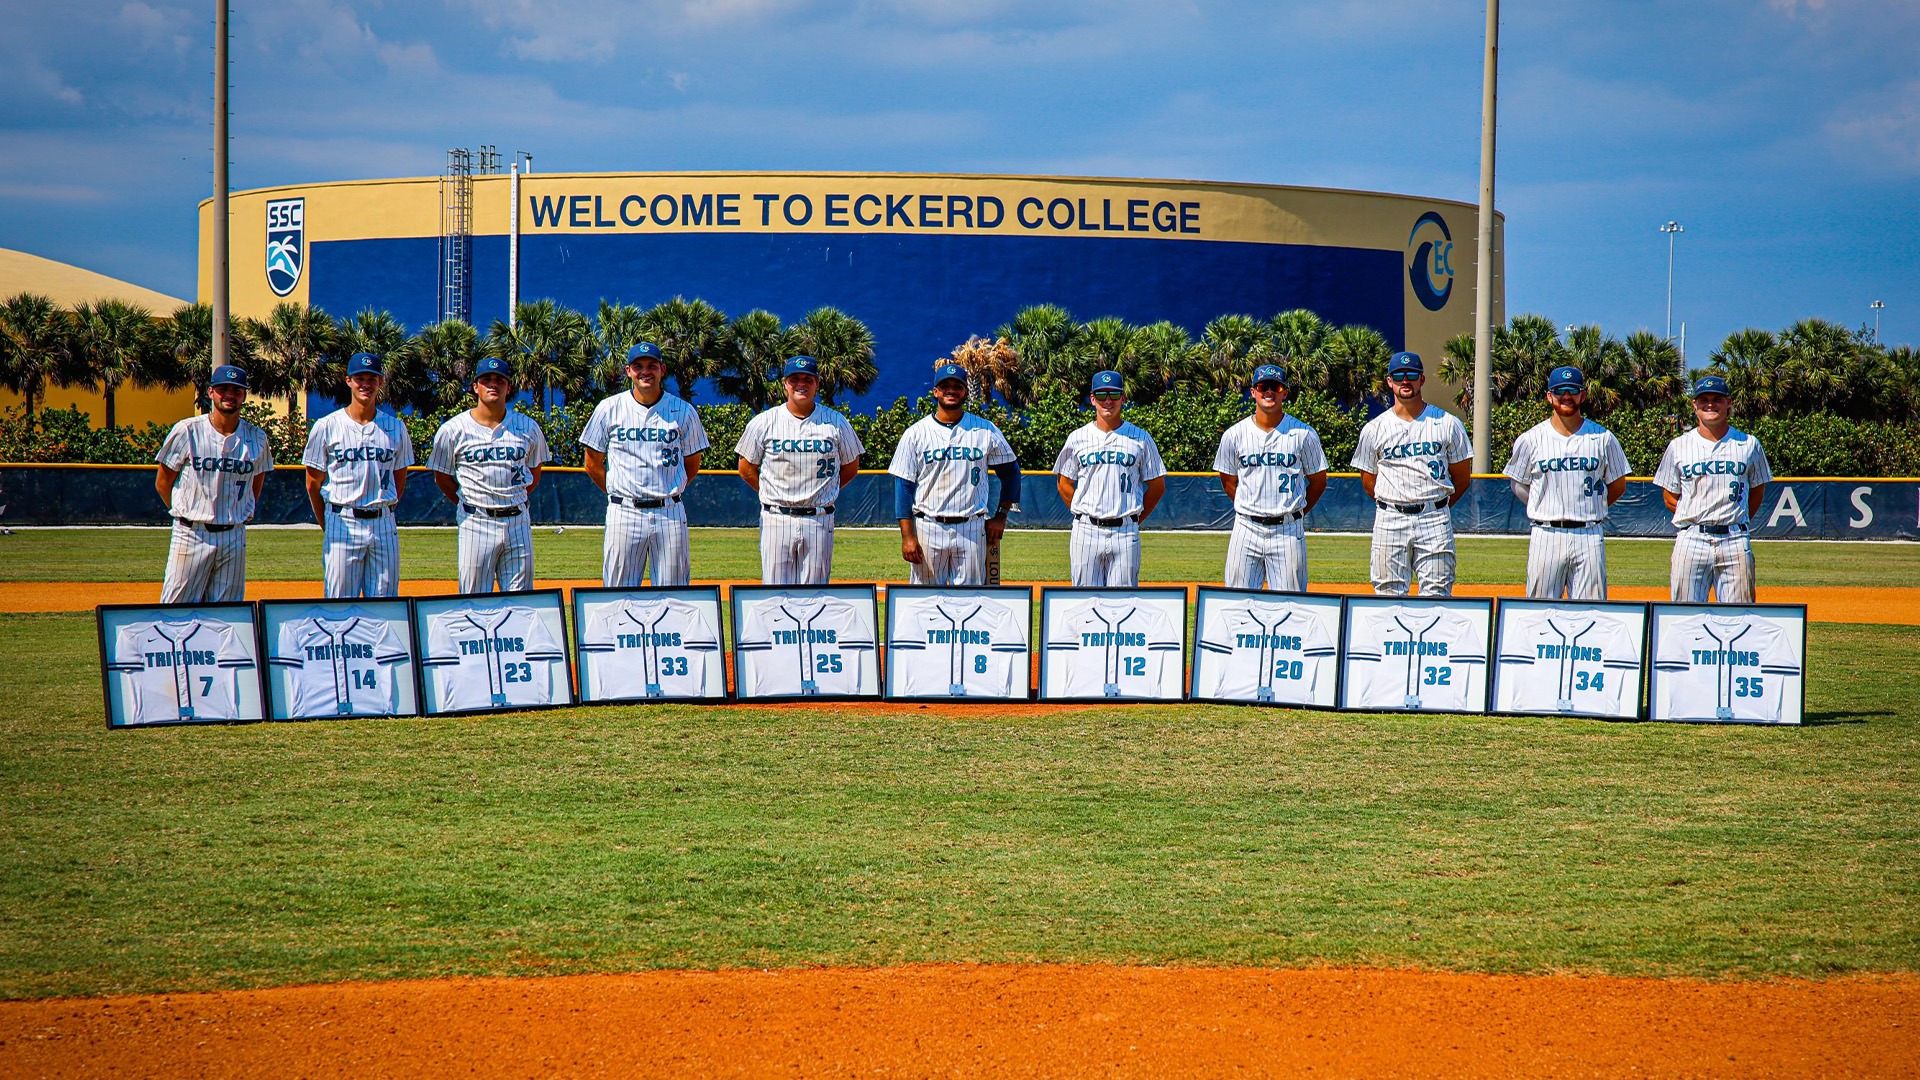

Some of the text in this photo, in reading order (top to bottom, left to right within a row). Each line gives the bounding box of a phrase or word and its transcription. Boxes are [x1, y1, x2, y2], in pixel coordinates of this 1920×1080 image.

[269, 204, 302, 228] SSC
[529, 193, 1201, 234] WELCOME TO ECKERD COLLEGE
[1434, 240, 1455, 276] EC
[617, 427, 679, 444] ECKERD
[334, 446, 394, 463] ECKERD
[464, 446, 526, 463] ECKERD
[773, 439, 834, 454] ECKERD
[923, 446, 984, 464] ECKERD
[1383, 441, 1442, 460] ECKERD
[192, 456, 254, 475] ECKERD
[816, 458, 836, 479] 25
[1079, 450, 1137, 468] ECKERD
[1239, 452, 1298, 468] ECKERD
[1538, 456, 1600, 474] ECKERD
[970, 467, 981, 487] 8
[1682, 460, 1747, 479] ECKERD
[235, 480, 247, 501] 7
[1583, 476, 1605, 497] 34
[459, 637, 525, 655] TRITONS
[617, 632, 682, 648] TRITONS
[773, 629, 836, 645] TRITONS
[927, 629, 990, 645] TRITONS
[1082, 632, 1145, 647] TRITONS
[1236, 634, 1302, 650] TRITONS
[305, 643, 373, 661] TRITONS
[1384, 641, 1448, 656] TRITONS
[1536, 644, 1602, 662] TRITONS
[145, 650, 216, 668] TRITONS
[661, 656, 689, 676] 33
[816, 653, 843, 673] 25
[974, 654, 987, 674] 8
[1123, 656, 1147, 676] 12
[1692, 650, 1760, 667] TRITONS
[351, 669, 377, 689] 14
[504, 662, 532, 683] 23
[1275, 659, 1304, 680] 20
[1423, 666, 1452, 685] 32
[199, 676, 214, 697] 7
[1575, 670, 1604, 692] 34
[1735, 677, 1764, 698] 35
